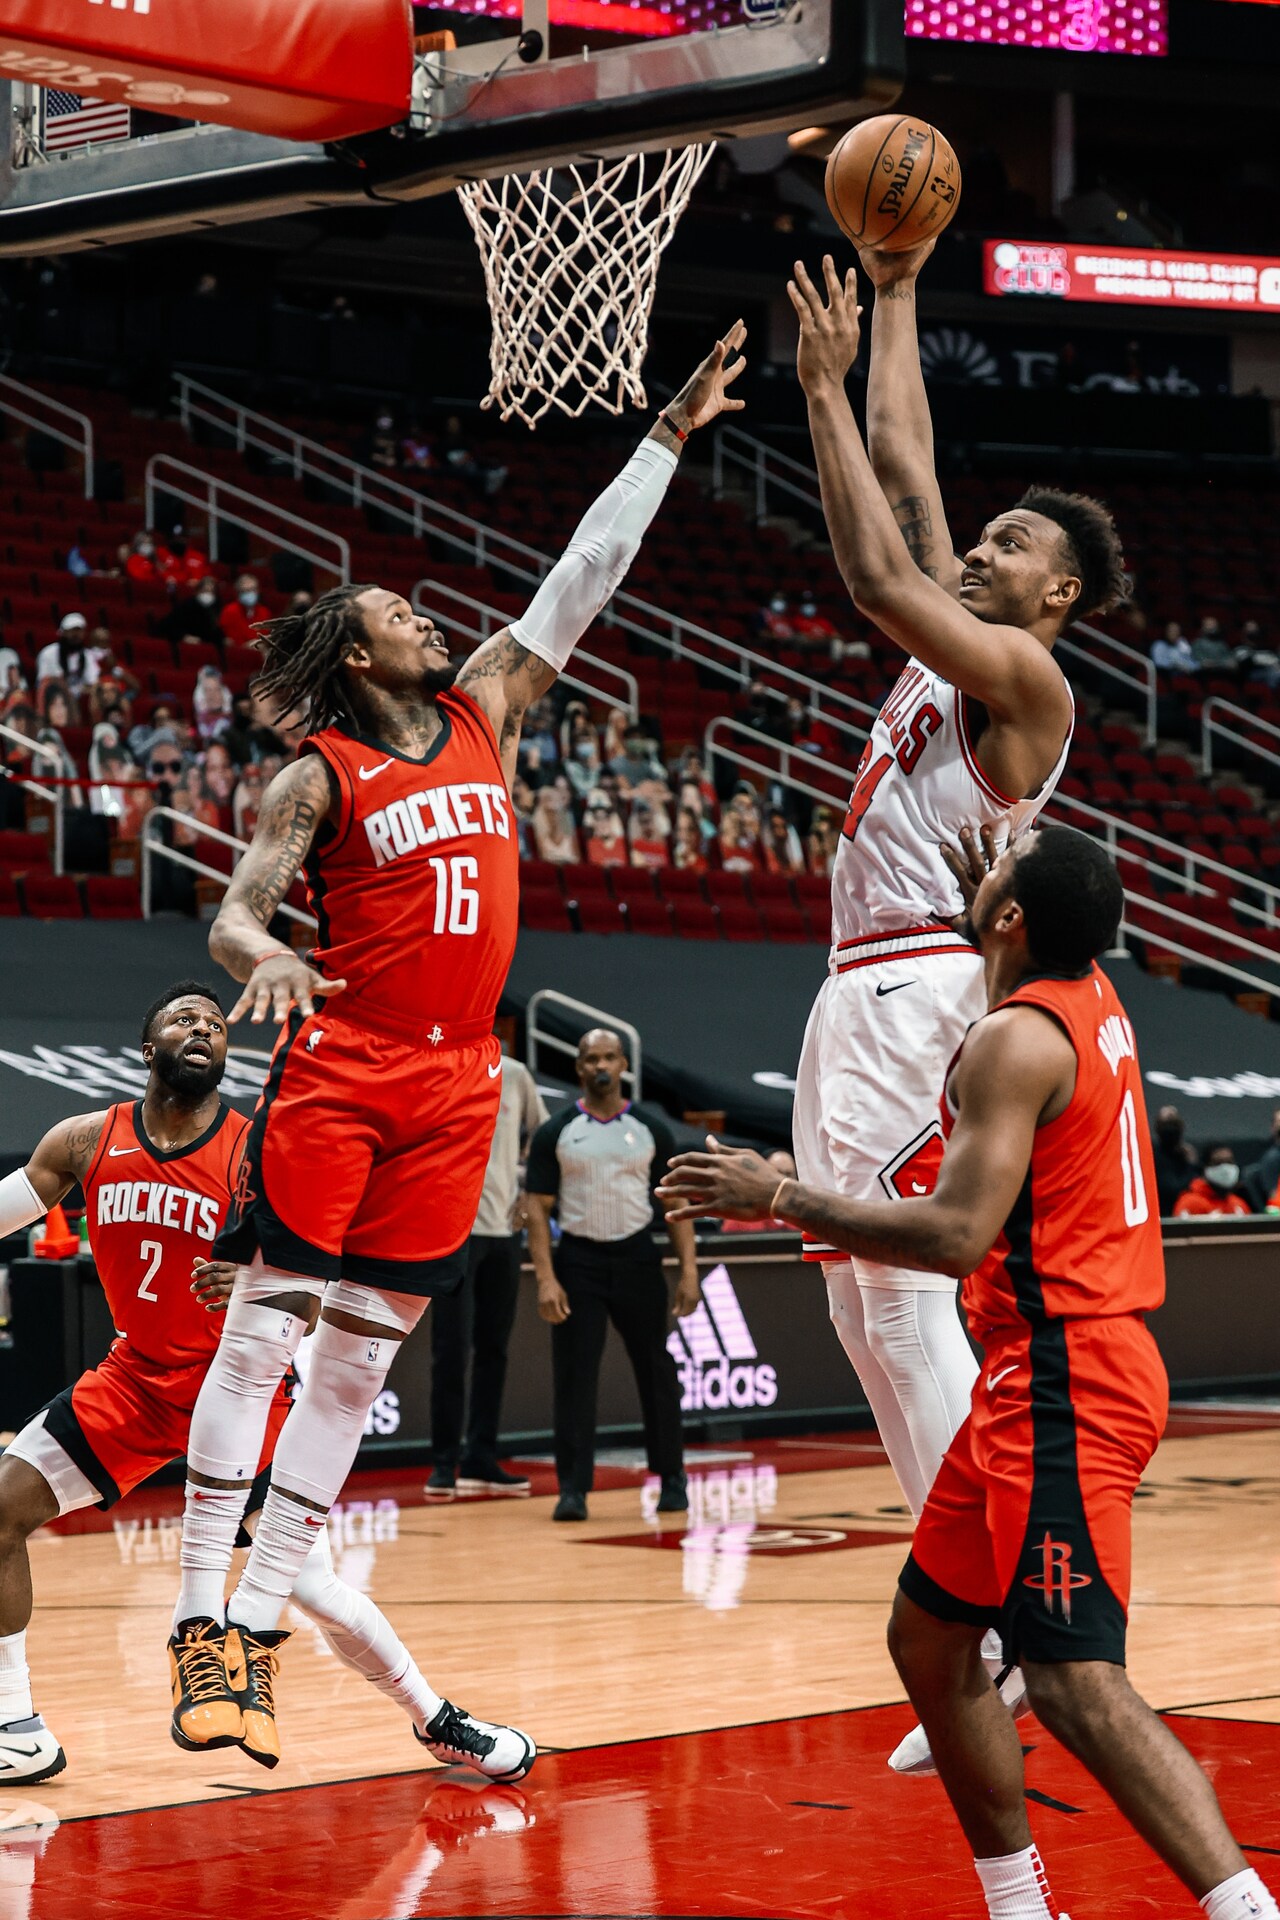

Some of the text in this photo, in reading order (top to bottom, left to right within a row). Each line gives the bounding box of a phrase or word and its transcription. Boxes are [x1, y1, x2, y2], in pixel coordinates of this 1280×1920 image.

[877, 127, 929, 220] SPALDING
[995, 266, 1072, 294] CLUB
[363, 783, 510, 869] ROCKETS
[428, 856, 480, 935] 16
[1119, 1089, 1149, 1228] 0
[97, 1181, 220, 1242] ROCKETS
[137, 1239, 163, 1303] 2
[677, 1357, 778, 1412] didas
